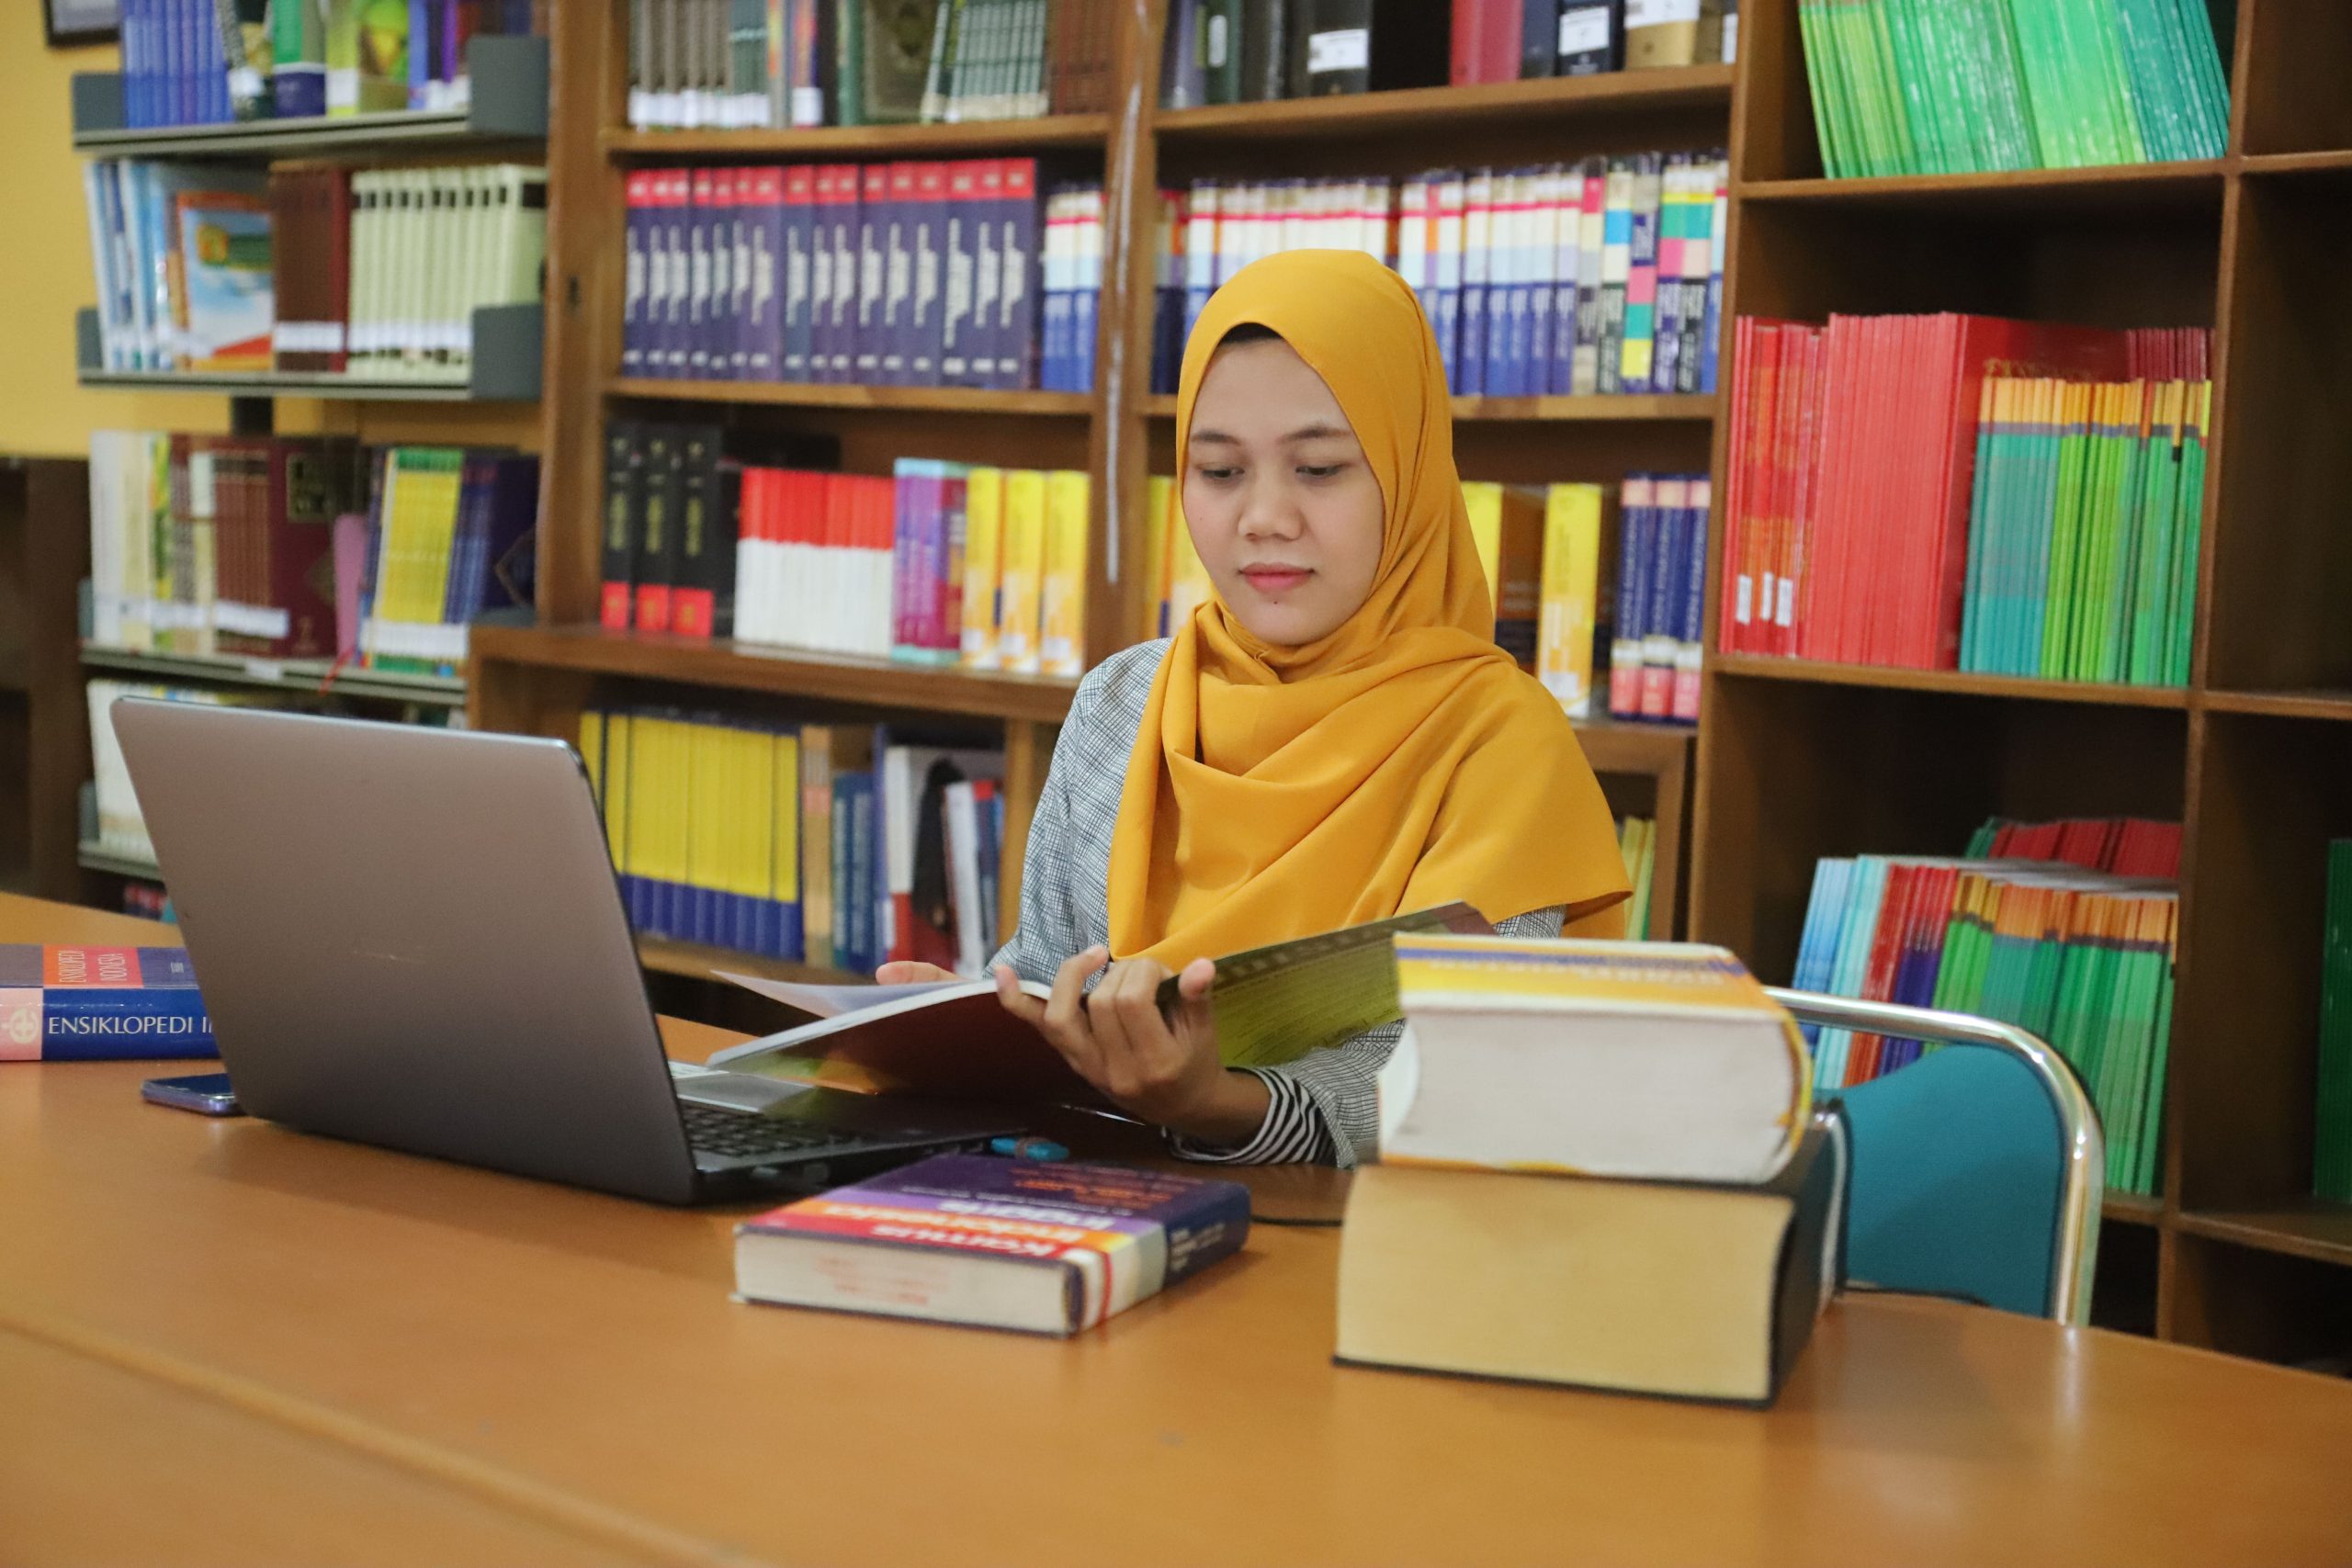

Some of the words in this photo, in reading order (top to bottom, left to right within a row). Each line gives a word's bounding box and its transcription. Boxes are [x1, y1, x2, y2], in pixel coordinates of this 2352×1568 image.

[58, 950, 86, 983] ENSIKLOPEDI
[48, 1016, 192, 1034] ENSIKLOPEDI
[872, 1224, 1054, 1256] Kamus
